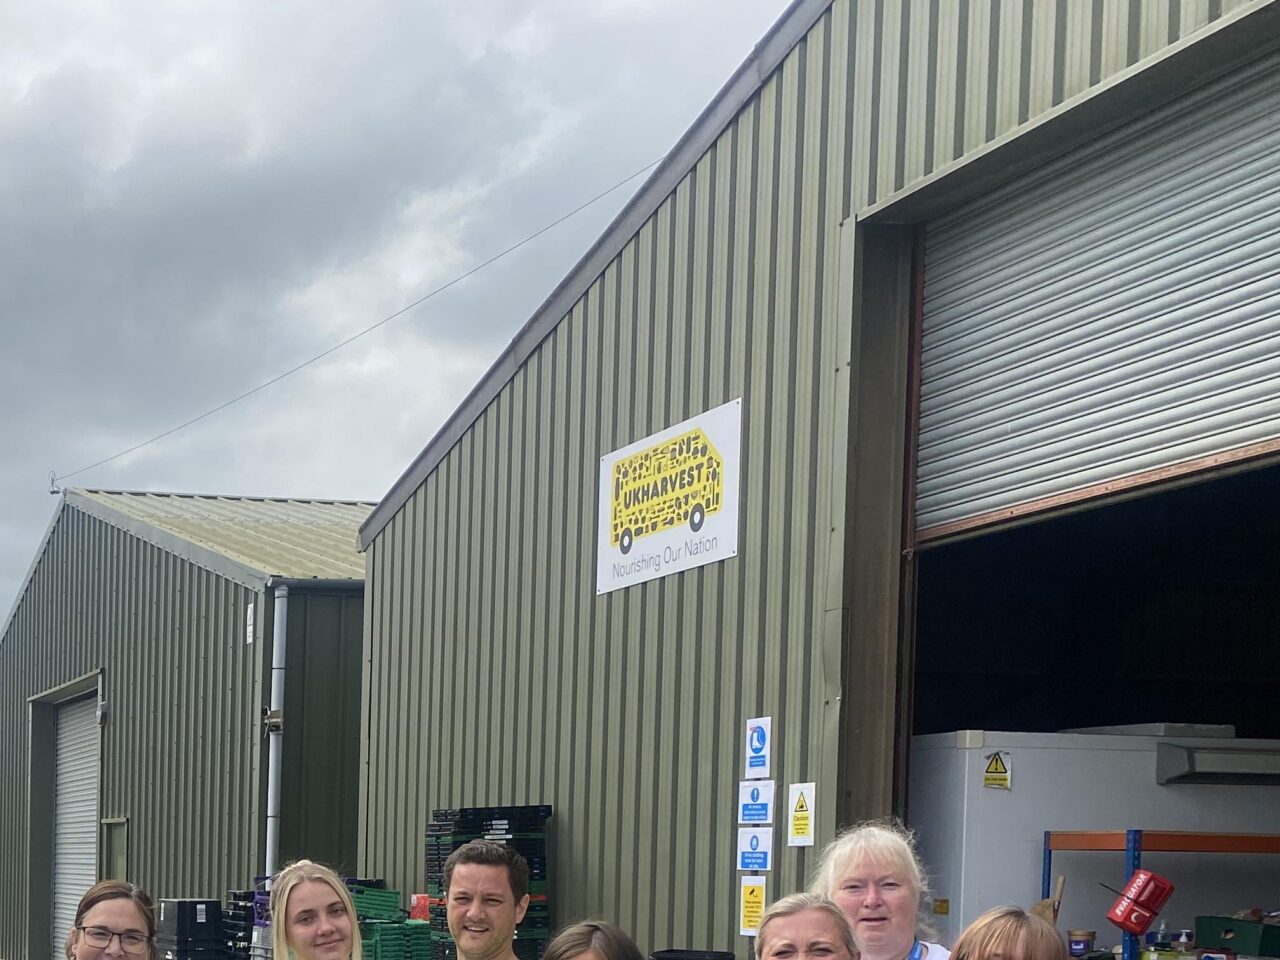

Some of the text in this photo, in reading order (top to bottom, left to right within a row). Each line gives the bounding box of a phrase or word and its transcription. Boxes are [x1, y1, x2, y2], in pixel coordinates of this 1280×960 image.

[623, 463, 705, 510] UKHARVEST
[612, 536, 718, 579] Nourishing Our Nation
